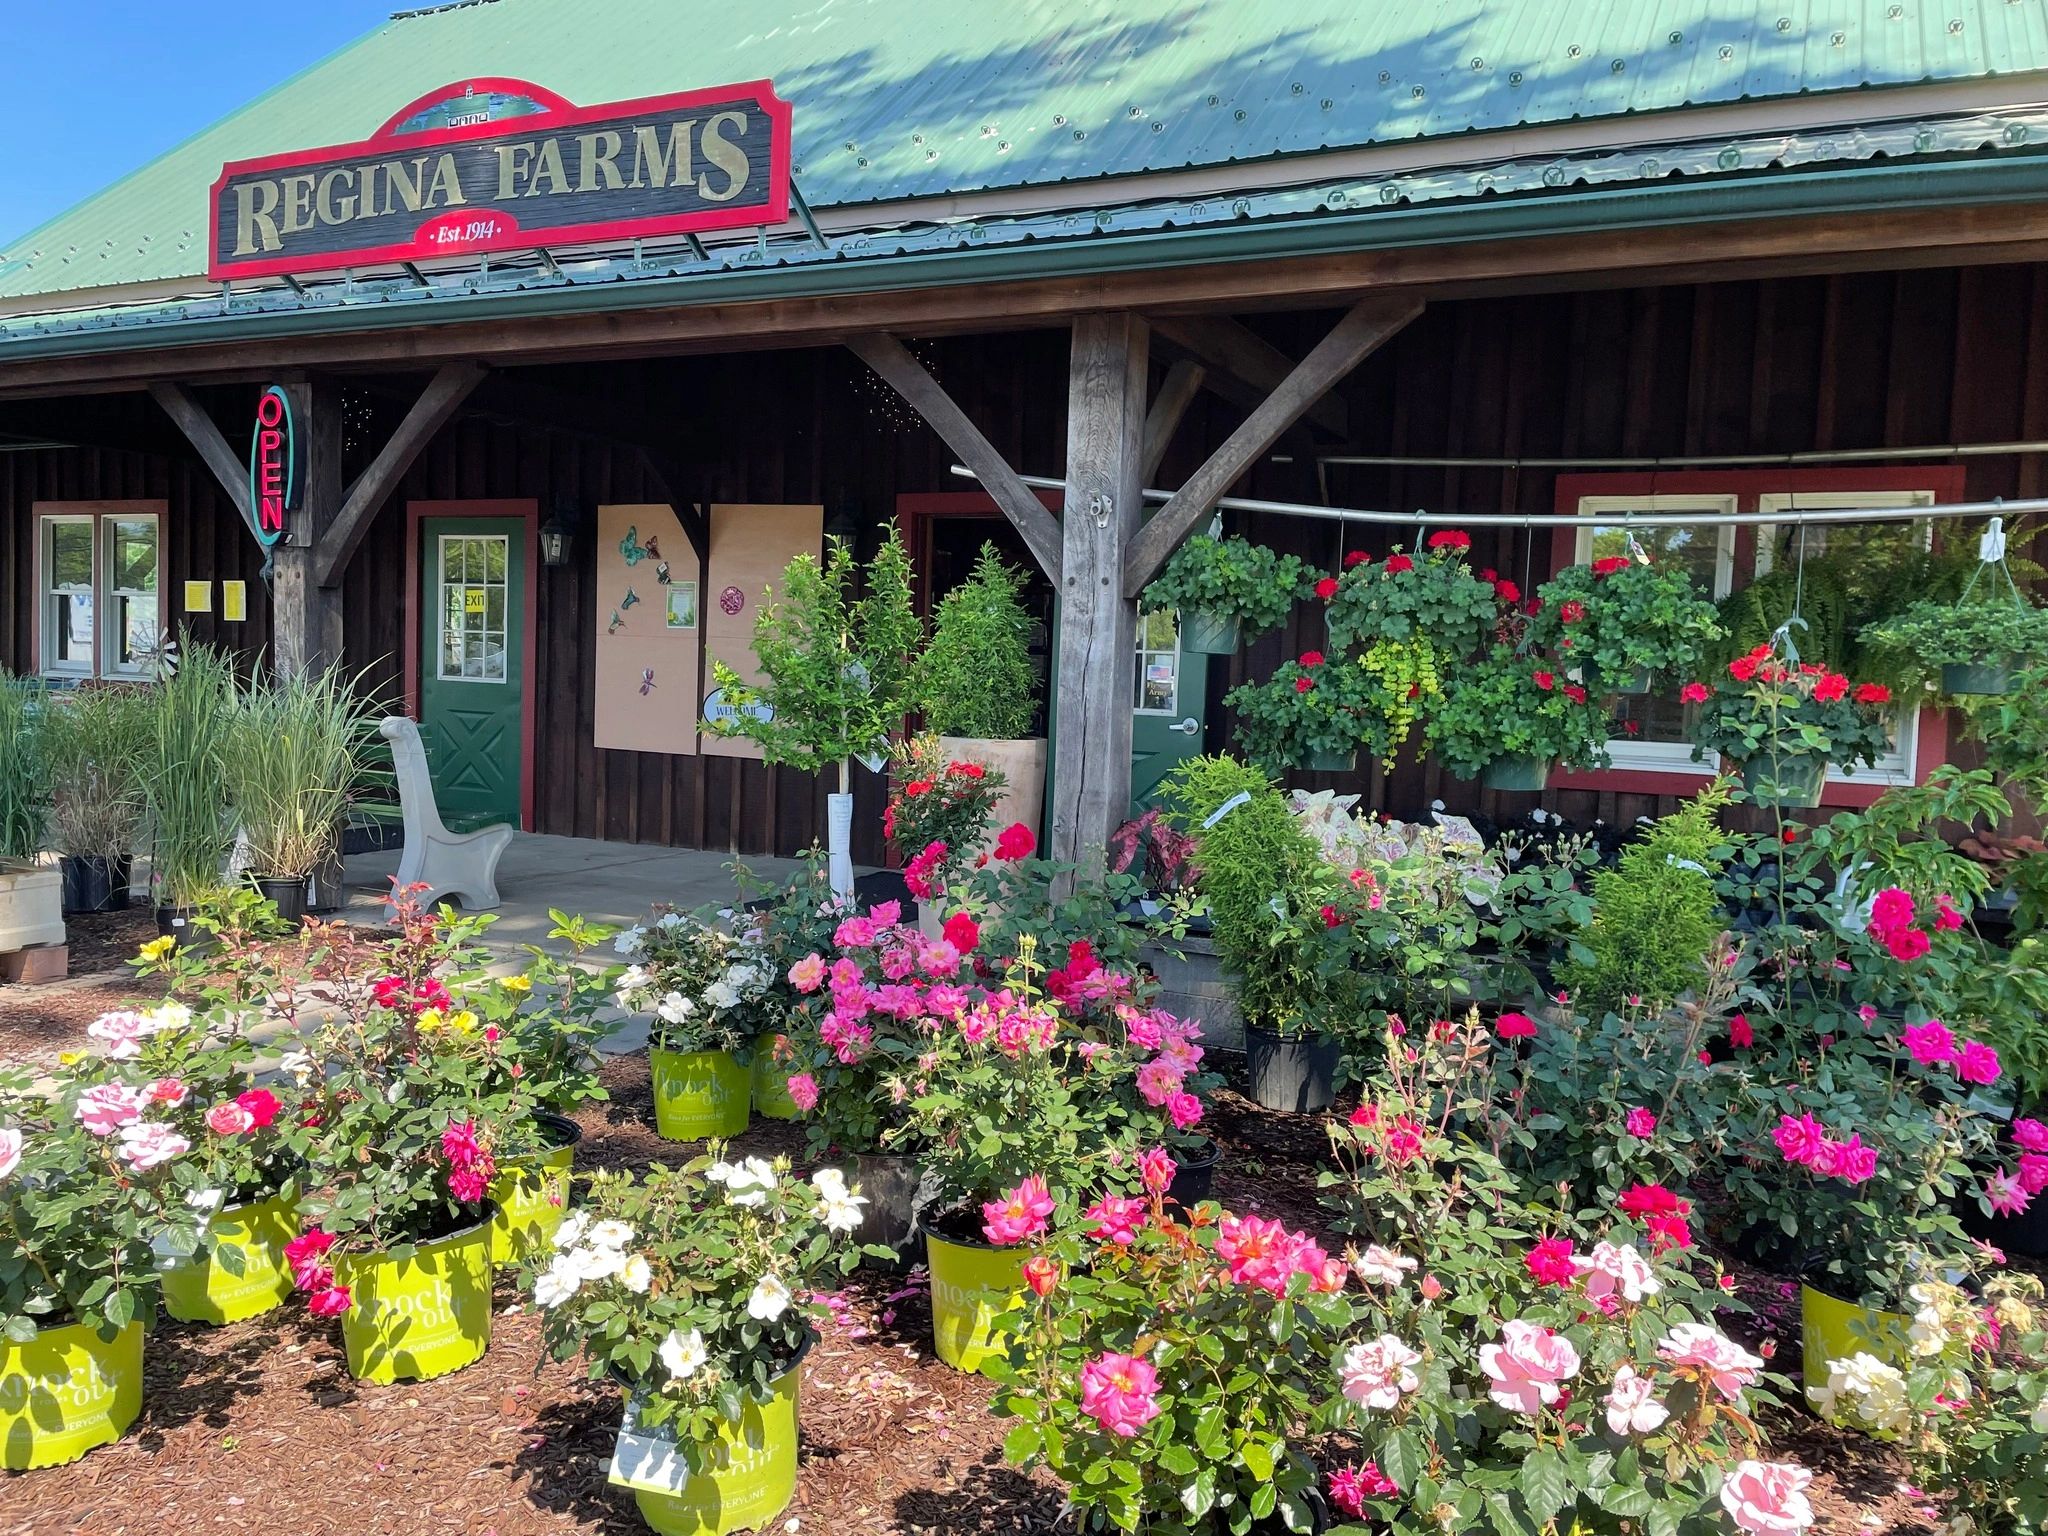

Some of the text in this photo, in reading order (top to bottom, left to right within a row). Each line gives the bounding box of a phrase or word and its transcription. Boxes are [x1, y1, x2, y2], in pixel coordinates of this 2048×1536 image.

[232, 111, 750, 258] REGINA FARMS
[258, 393, 282, 530] OPEN
[465, 594, 485, 607] EXIT
